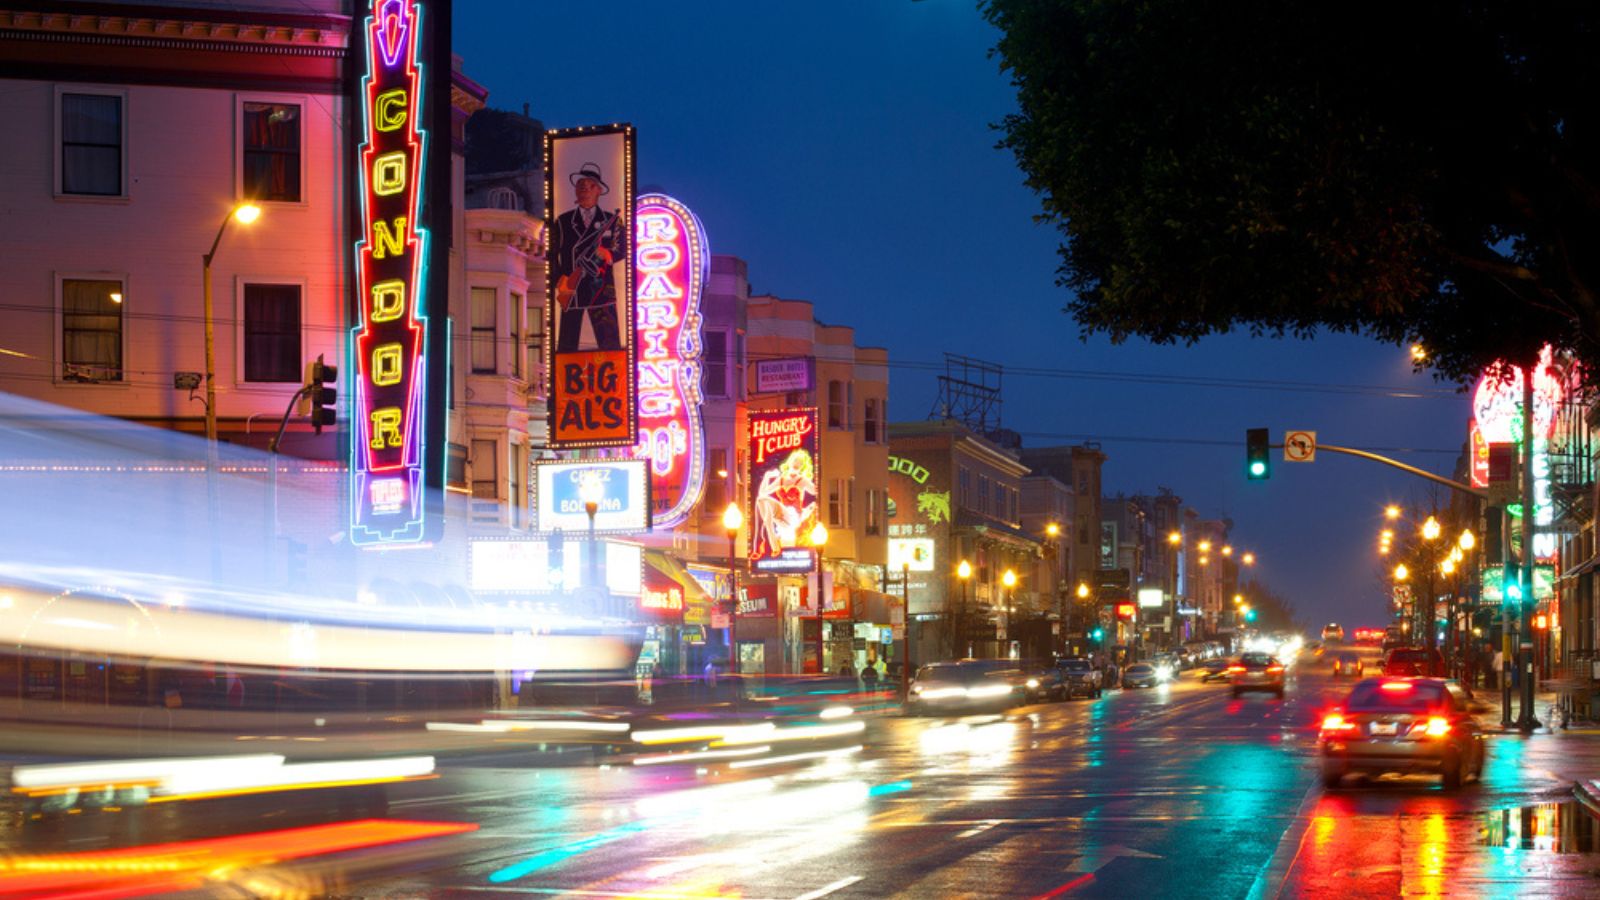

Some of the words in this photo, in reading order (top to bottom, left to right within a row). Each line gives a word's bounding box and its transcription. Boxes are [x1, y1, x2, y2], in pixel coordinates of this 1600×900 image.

[371, 88, 408, 450] CONDOR
[637, 213, 682, 417] ROARING
[564, 361, 618, 394] BIG
[761, 372, 807, 382] RESTAURANT
[787, 361, 806, 372] HOTEL
[559, 396, 623, 431] AL'S
[753, 415, 812, 438] HUNGRY
[766, 432, 801, 453] CLUB
